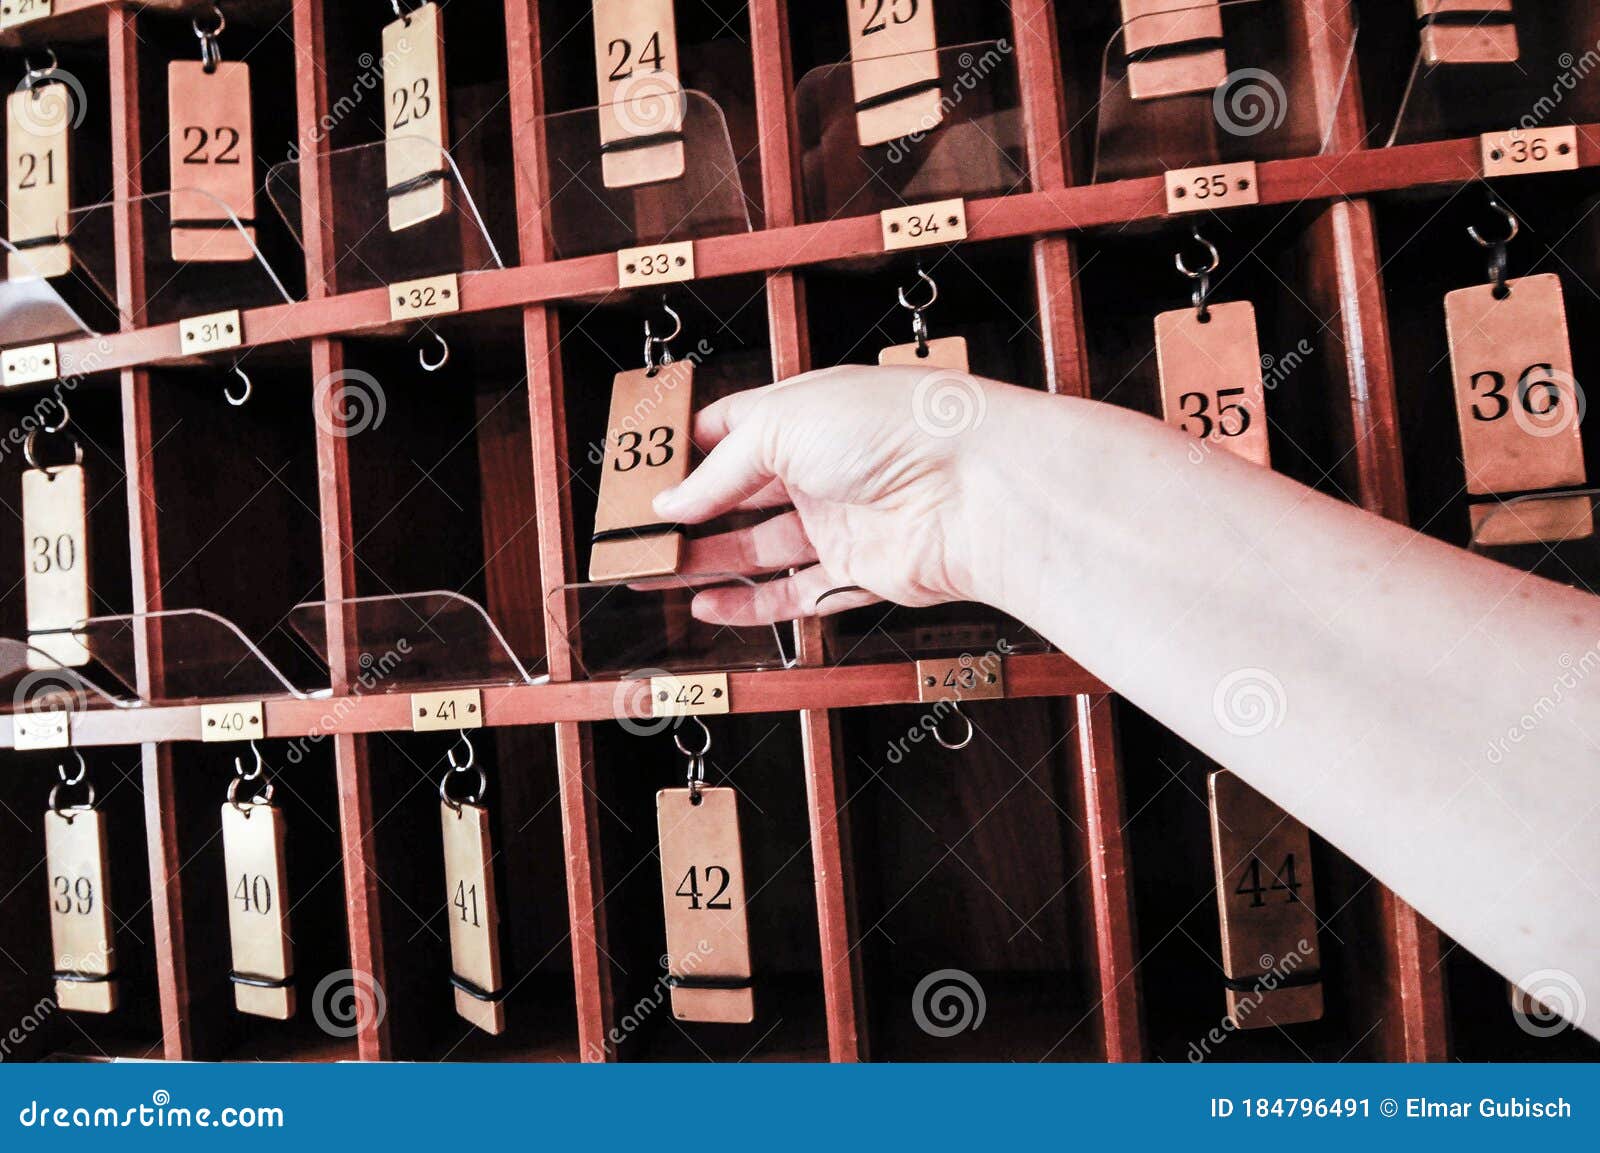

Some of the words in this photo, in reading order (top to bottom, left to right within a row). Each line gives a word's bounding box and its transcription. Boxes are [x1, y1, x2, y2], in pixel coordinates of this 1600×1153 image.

[862, 0, 918, 36] 25
[608, 31, 666, 82] 24
[392, 77, 431, 130] 23
[183, 126, 241, 166] 22
[1511, 138, 1548, 163] 36
[18, 150, 56, 190] 21
[1194, 174, 1228, 199] 35
[907, 215, 939, 237] 34
[640, 255, 670, 276] 33
[410, 287, 437, 308] 32
[201, 323, 221, 342] 31
[1470, 363, 1562, 422] 36
[1179, 387, 1250, 439] 35
[613, 426, 675, 472] 33
[32, 534, 75, 574] 30
[675, 685, 705, 706] 42
[943, 667, 976, 689] 43
[220, 713, 244, 732] 40
[436, 701, 457, 721] 41
[53, 875, 93, 915] 39
[234, 873, 271, 916] 40
[675, 865, 731, 910] 42
[1234, 853, 1303, 908] 44
[454, 880, 481, 928] 41
